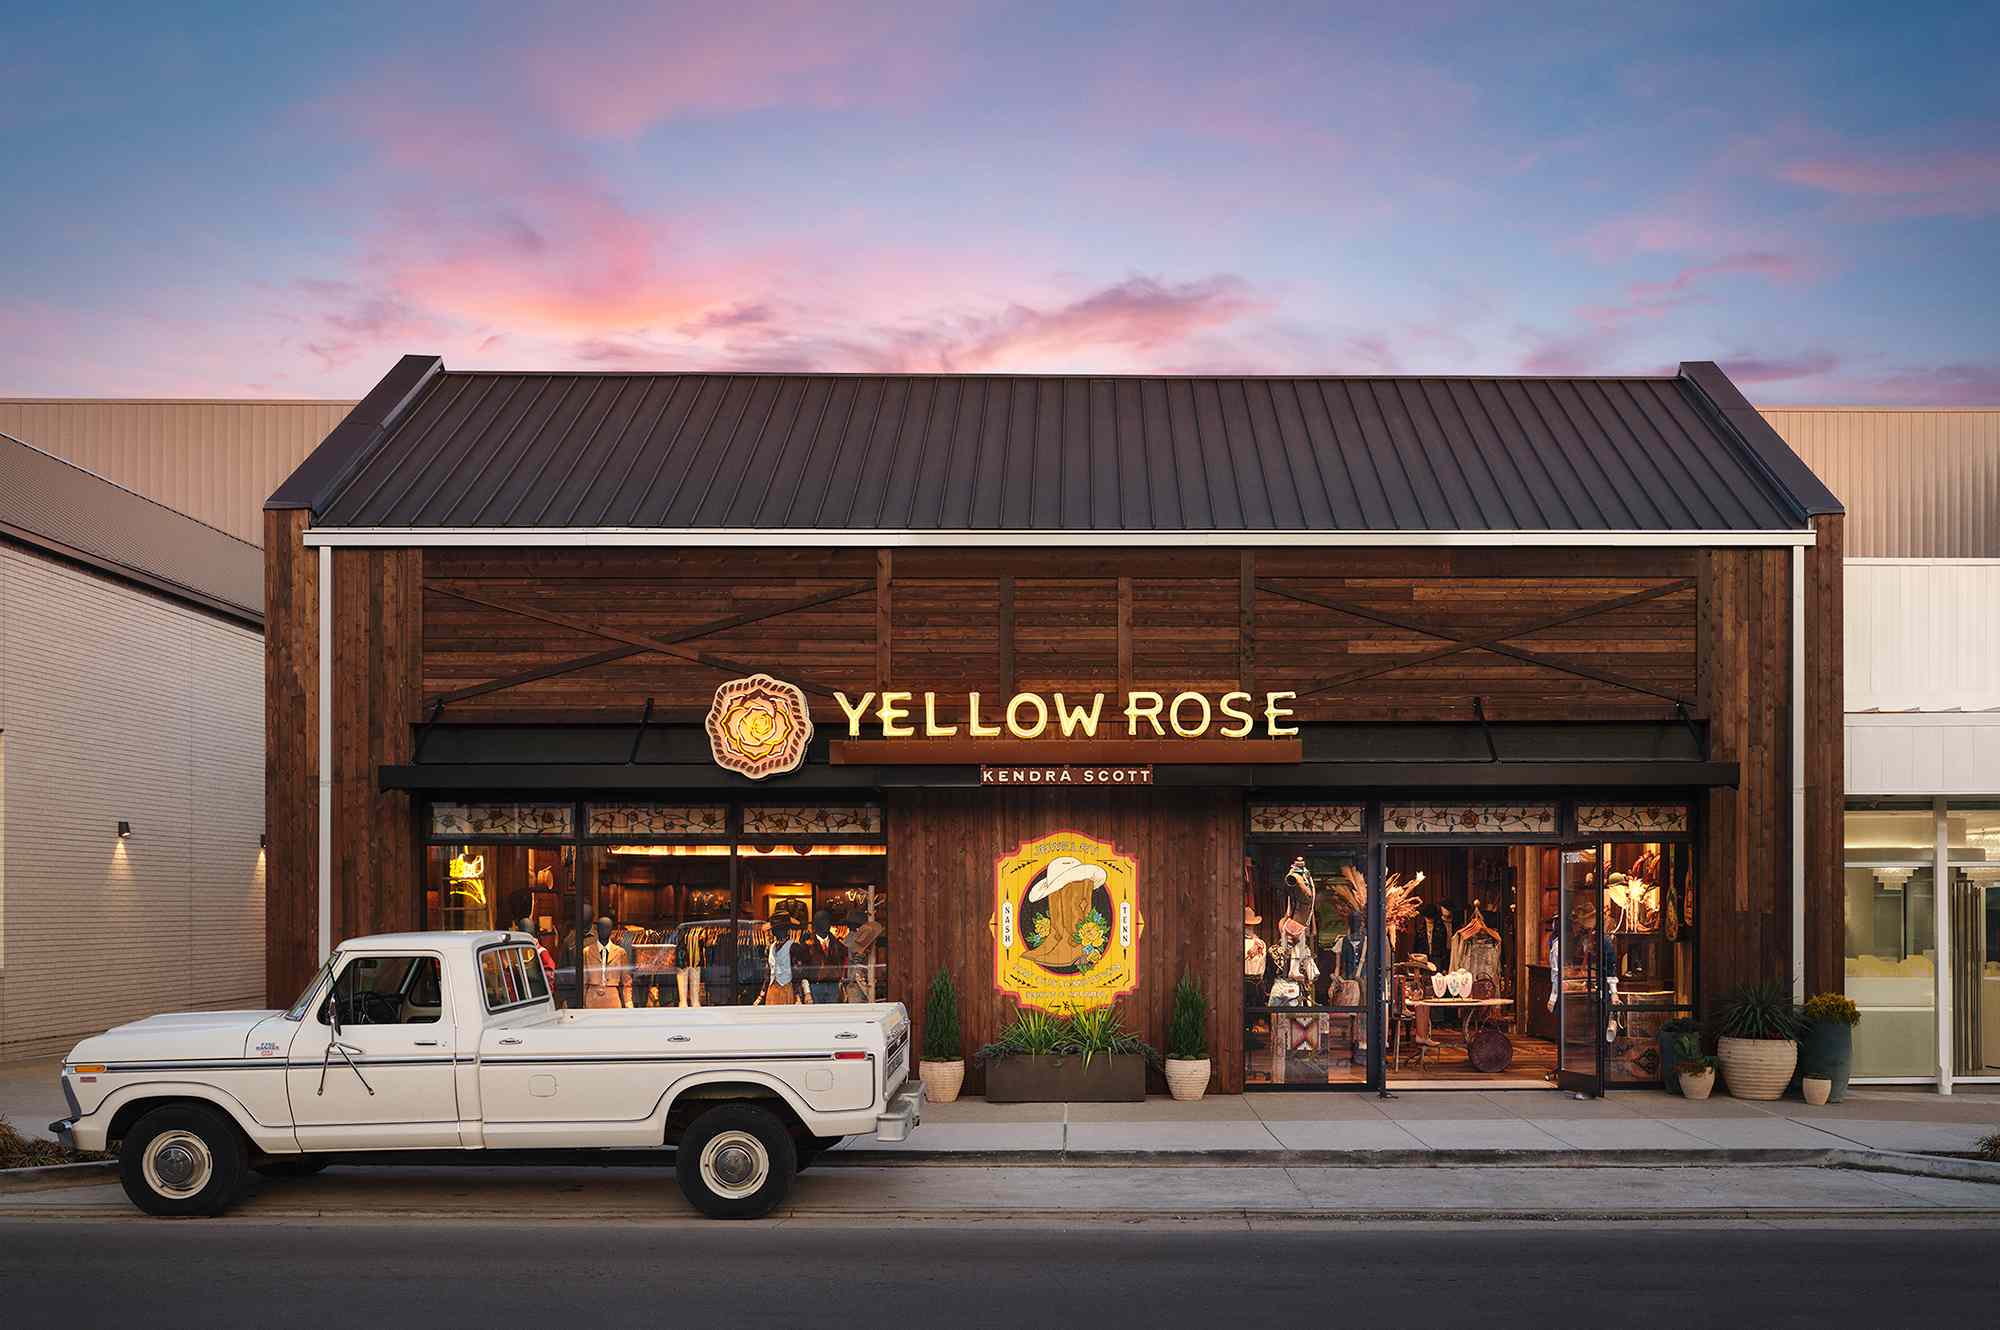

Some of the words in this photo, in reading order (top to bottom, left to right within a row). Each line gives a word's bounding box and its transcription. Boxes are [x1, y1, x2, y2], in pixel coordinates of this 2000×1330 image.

[832, 691, 1105, 739] YELLOW
[1123, 691, 1299, 738] ROSE
[982, 770, 1072, 782] KENDRA
[1083, 770, 1150, 782] SCOTT
